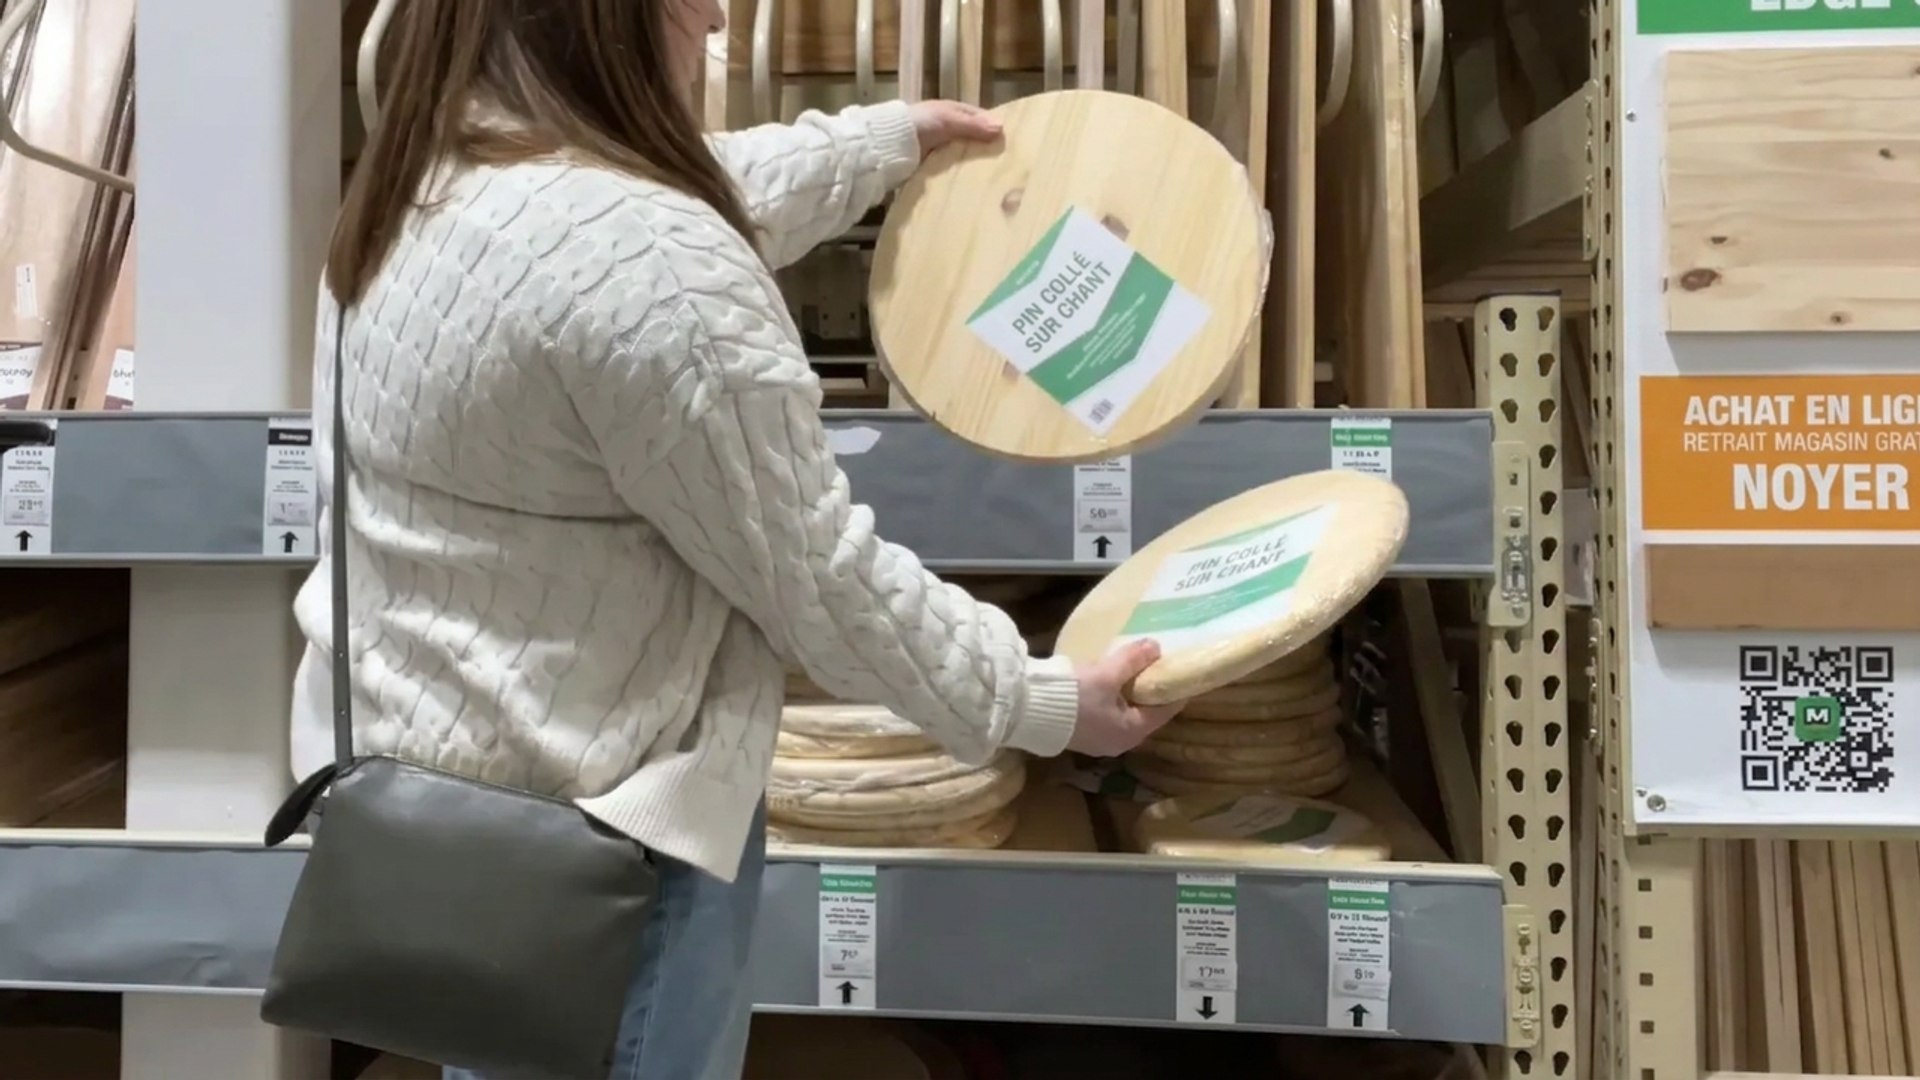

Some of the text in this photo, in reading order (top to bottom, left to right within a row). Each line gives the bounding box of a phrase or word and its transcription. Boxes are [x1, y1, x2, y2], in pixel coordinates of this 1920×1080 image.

[1012, 302, 1044, 336] PIN
[1040, 251, 1092, 305] COLLÉ
[1025, 316, 1063, 353] SUR
[1057, 261, 1111, 319] CHANT
[1683, 394, 1920, 425] ACHAT EN LIG
[1683, 431, 1768, 452] RETRAIT
[1774, 431, 1868, 452] MAGASIN
[1733, 463, 1910, 510] NOYER
